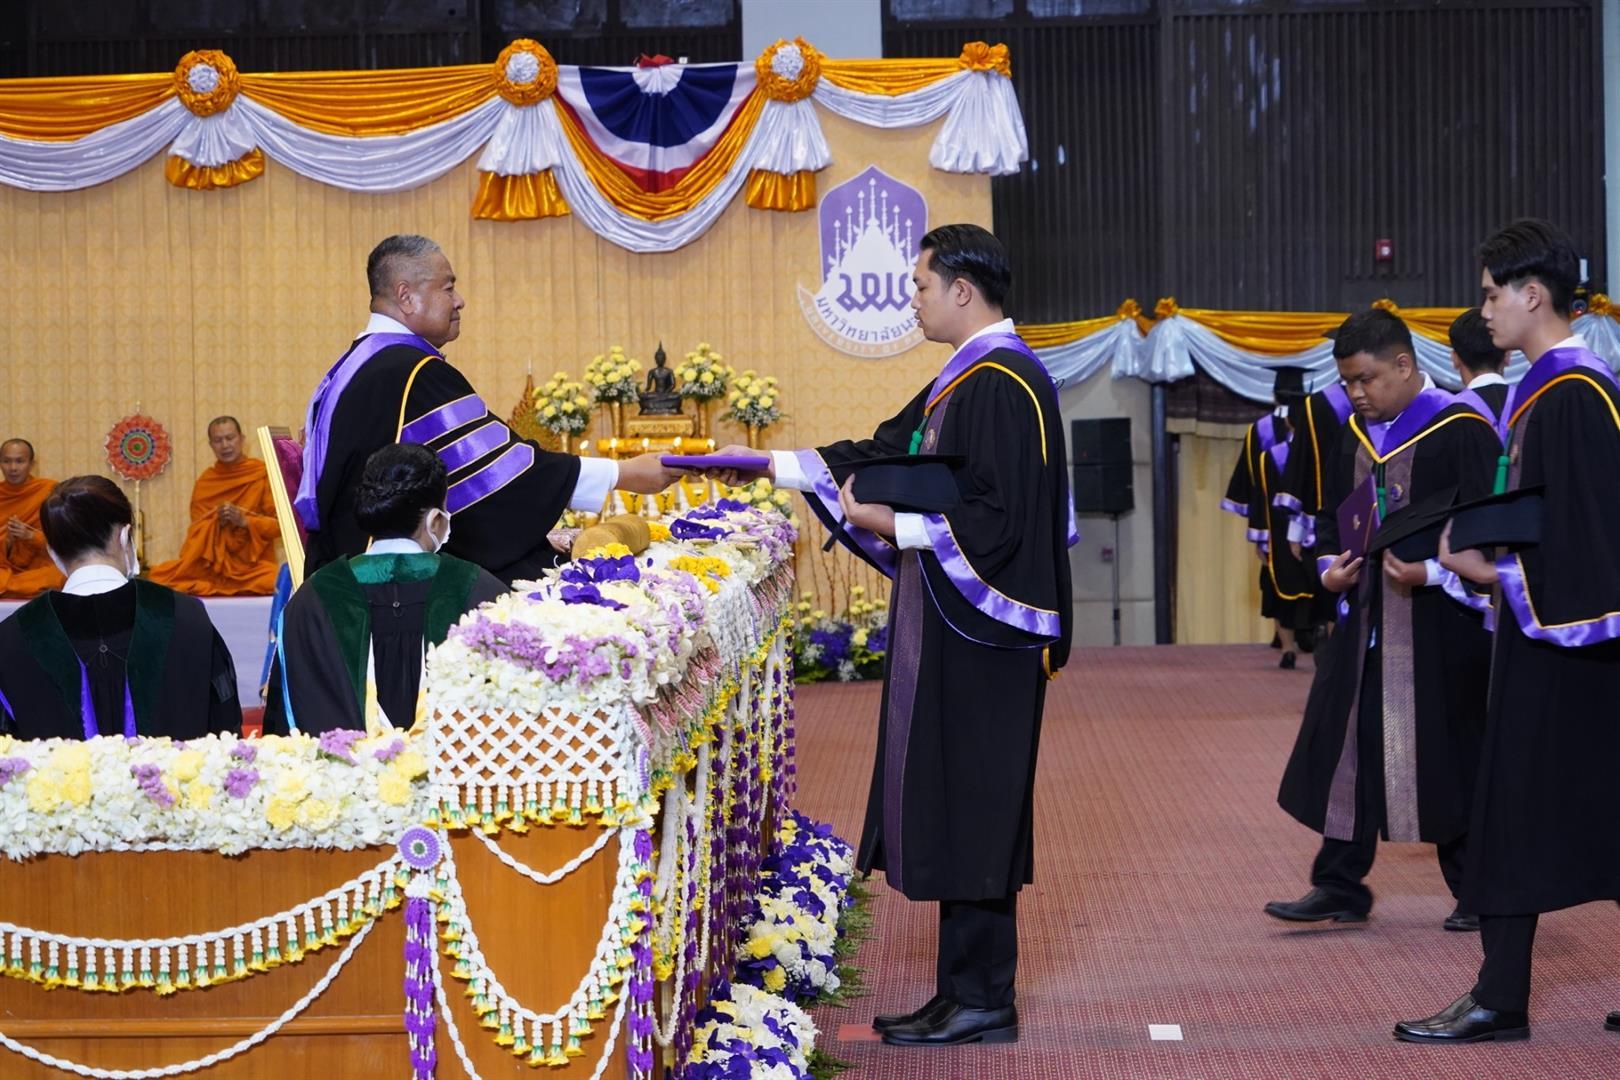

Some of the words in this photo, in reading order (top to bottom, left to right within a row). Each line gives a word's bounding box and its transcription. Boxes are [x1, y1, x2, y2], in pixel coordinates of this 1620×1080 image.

[816, 296, 919, 342] มหาวิทยาลัยพะ
